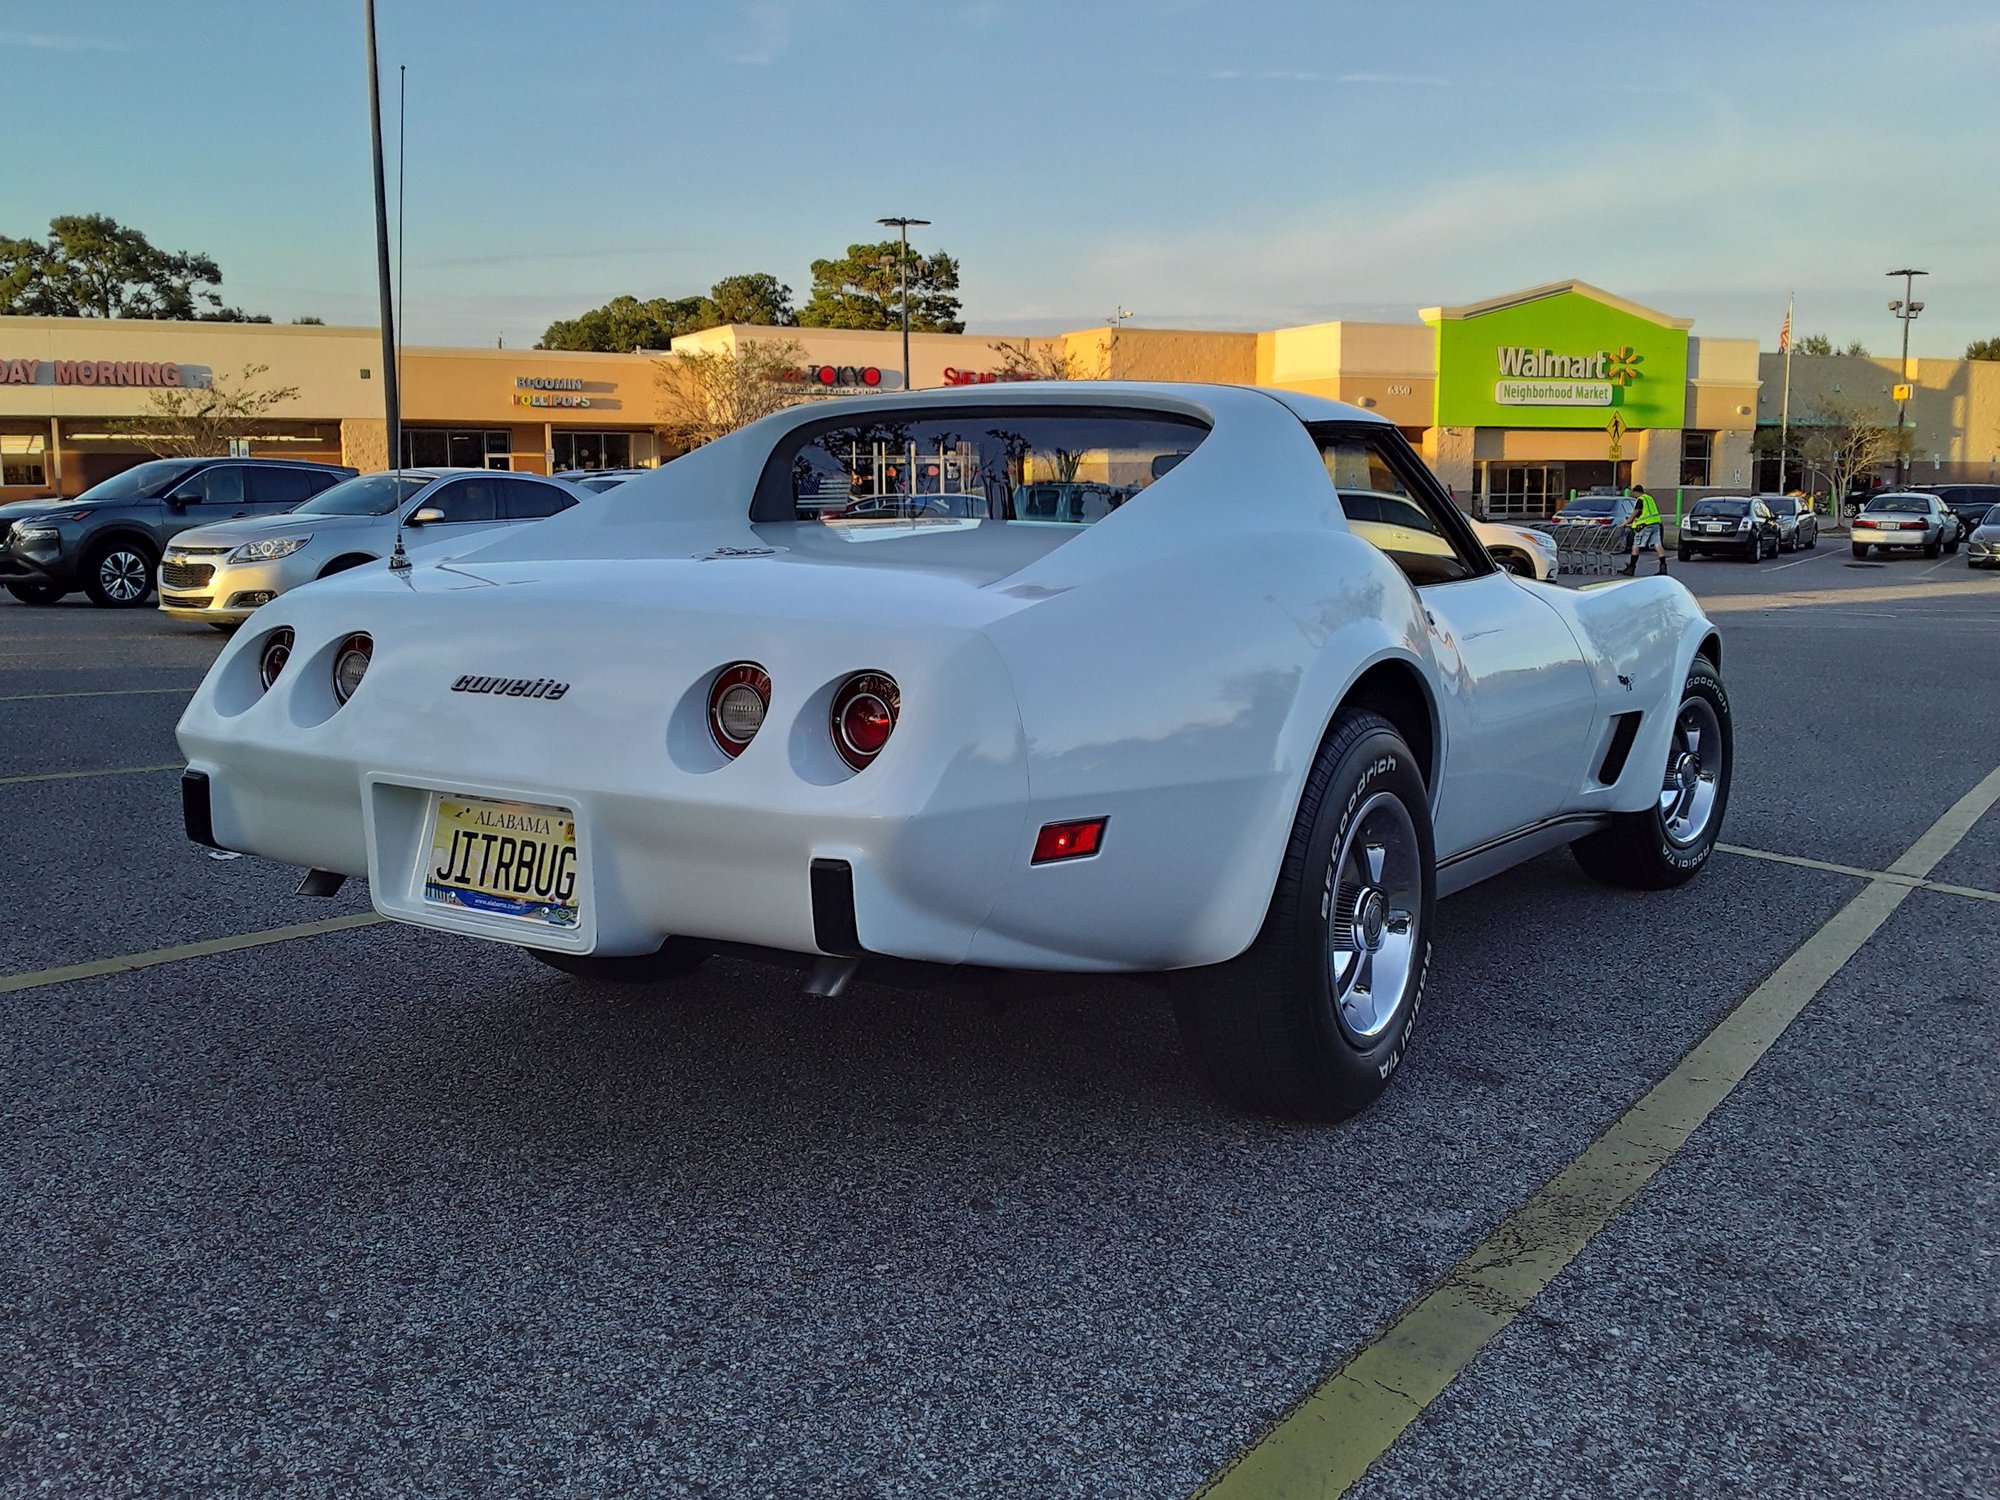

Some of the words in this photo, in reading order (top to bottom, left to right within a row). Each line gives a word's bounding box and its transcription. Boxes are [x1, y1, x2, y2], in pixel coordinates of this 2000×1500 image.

[54, 360, 181, 387] MORNING
[808, 365, 881, 386] TOKYO
[1497, 347, 1606, 378] Walmart
[1503, 384, 1573, 401] Neighborhood
[1575, 386, 1608, 399] Market
[474, 810, 550, 835] ALABAMA
[436, 829, 577, 901] JITRBUG
